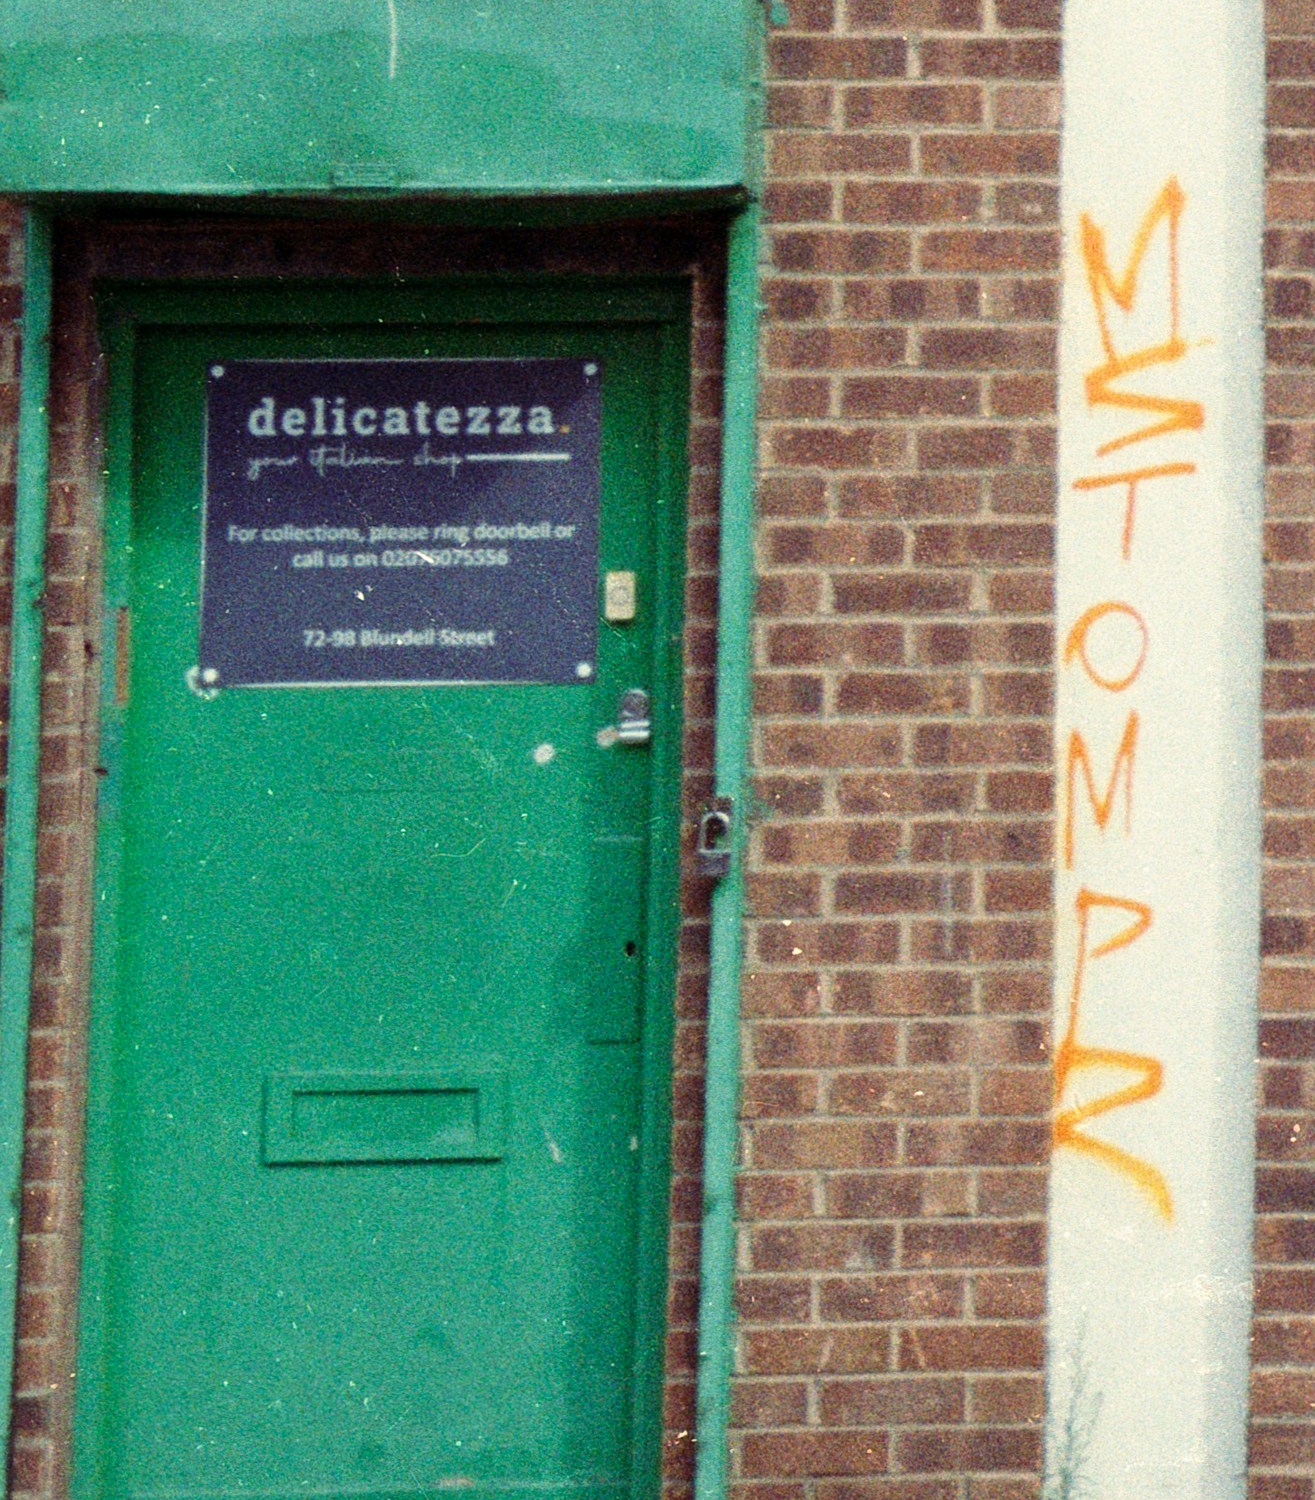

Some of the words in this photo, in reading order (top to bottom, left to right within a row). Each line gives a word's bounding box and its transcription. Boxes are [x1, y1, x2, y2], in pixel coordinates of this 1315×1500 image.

[248, 455, 299, 481] your
[412, 442, 462, 479] shop
[228, 524, 258, 541] For
[261, 523, 365, 543] collections,
[369, 523, 429, 544] please
[434, 522, 470, 544] ring
[473, 522, 551, 540] doorbell
[555, 525, 576, 540] or
[292, 550, 324, 568] call
[328, 553, 349, 568] us
[353, 553, 378, 567] on
[303, 629, 356, 648] 72-98
[360, 628, 435, 646] Blundell
[439, 628, 496, 646] Street
